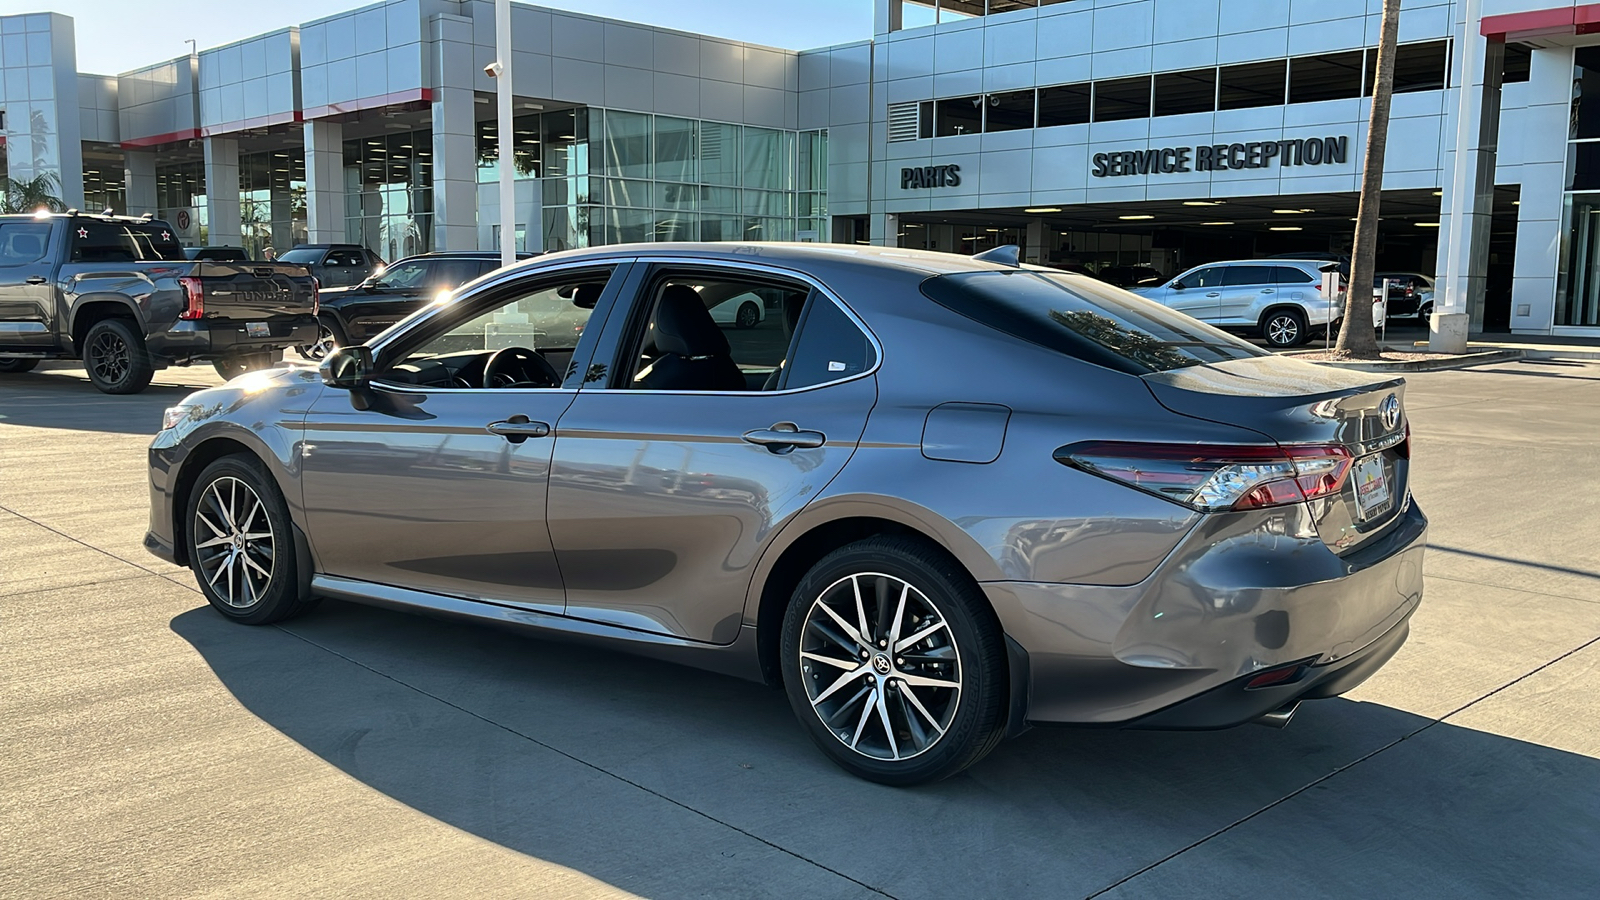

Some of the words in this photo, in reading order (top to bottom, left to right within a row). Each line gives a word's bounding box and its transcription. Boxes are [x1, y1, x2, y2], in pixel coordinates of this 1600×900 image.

[1092, 147, 1191, 177] SERVICE
[1195, 136, 1348, 171] RECEPTION
[901, 164, 961, 189] PARTS
